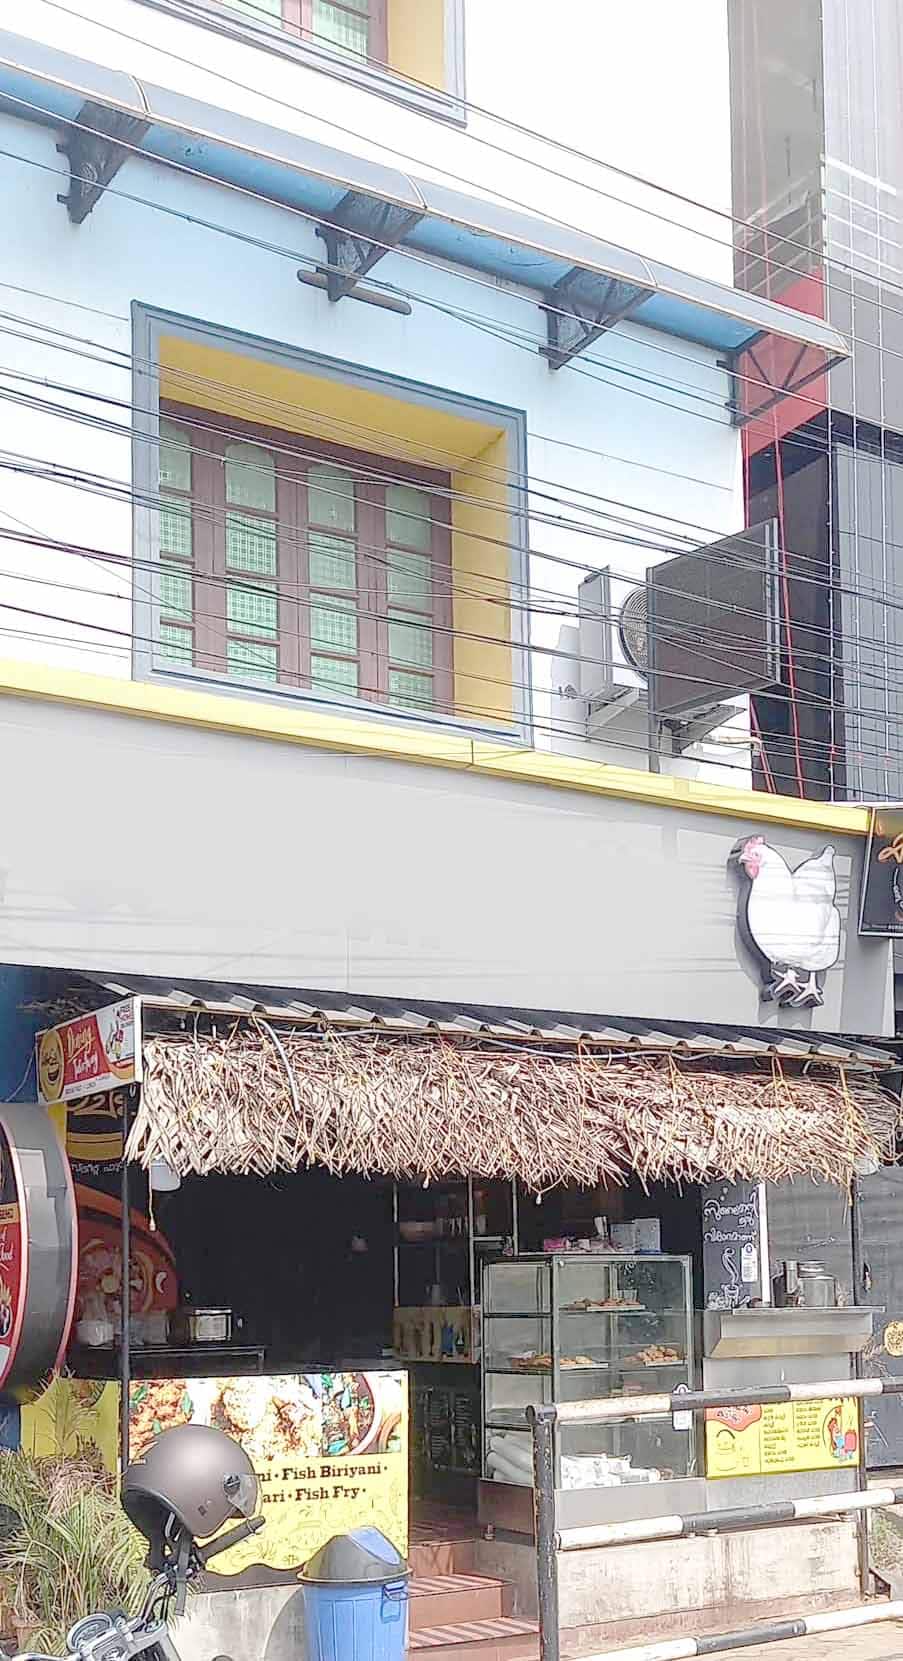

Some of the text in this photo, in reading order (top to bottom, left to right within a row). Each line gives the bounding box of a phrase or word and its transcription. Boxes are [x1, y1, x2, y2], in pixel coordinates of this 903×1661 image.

[282, 1466, 316, 1480] Fish
[320, 1462, 381, 1478] Biriyani
[295, 1487, 329, 1501] Fish
[332, 1485, 360, 1499] Fry
